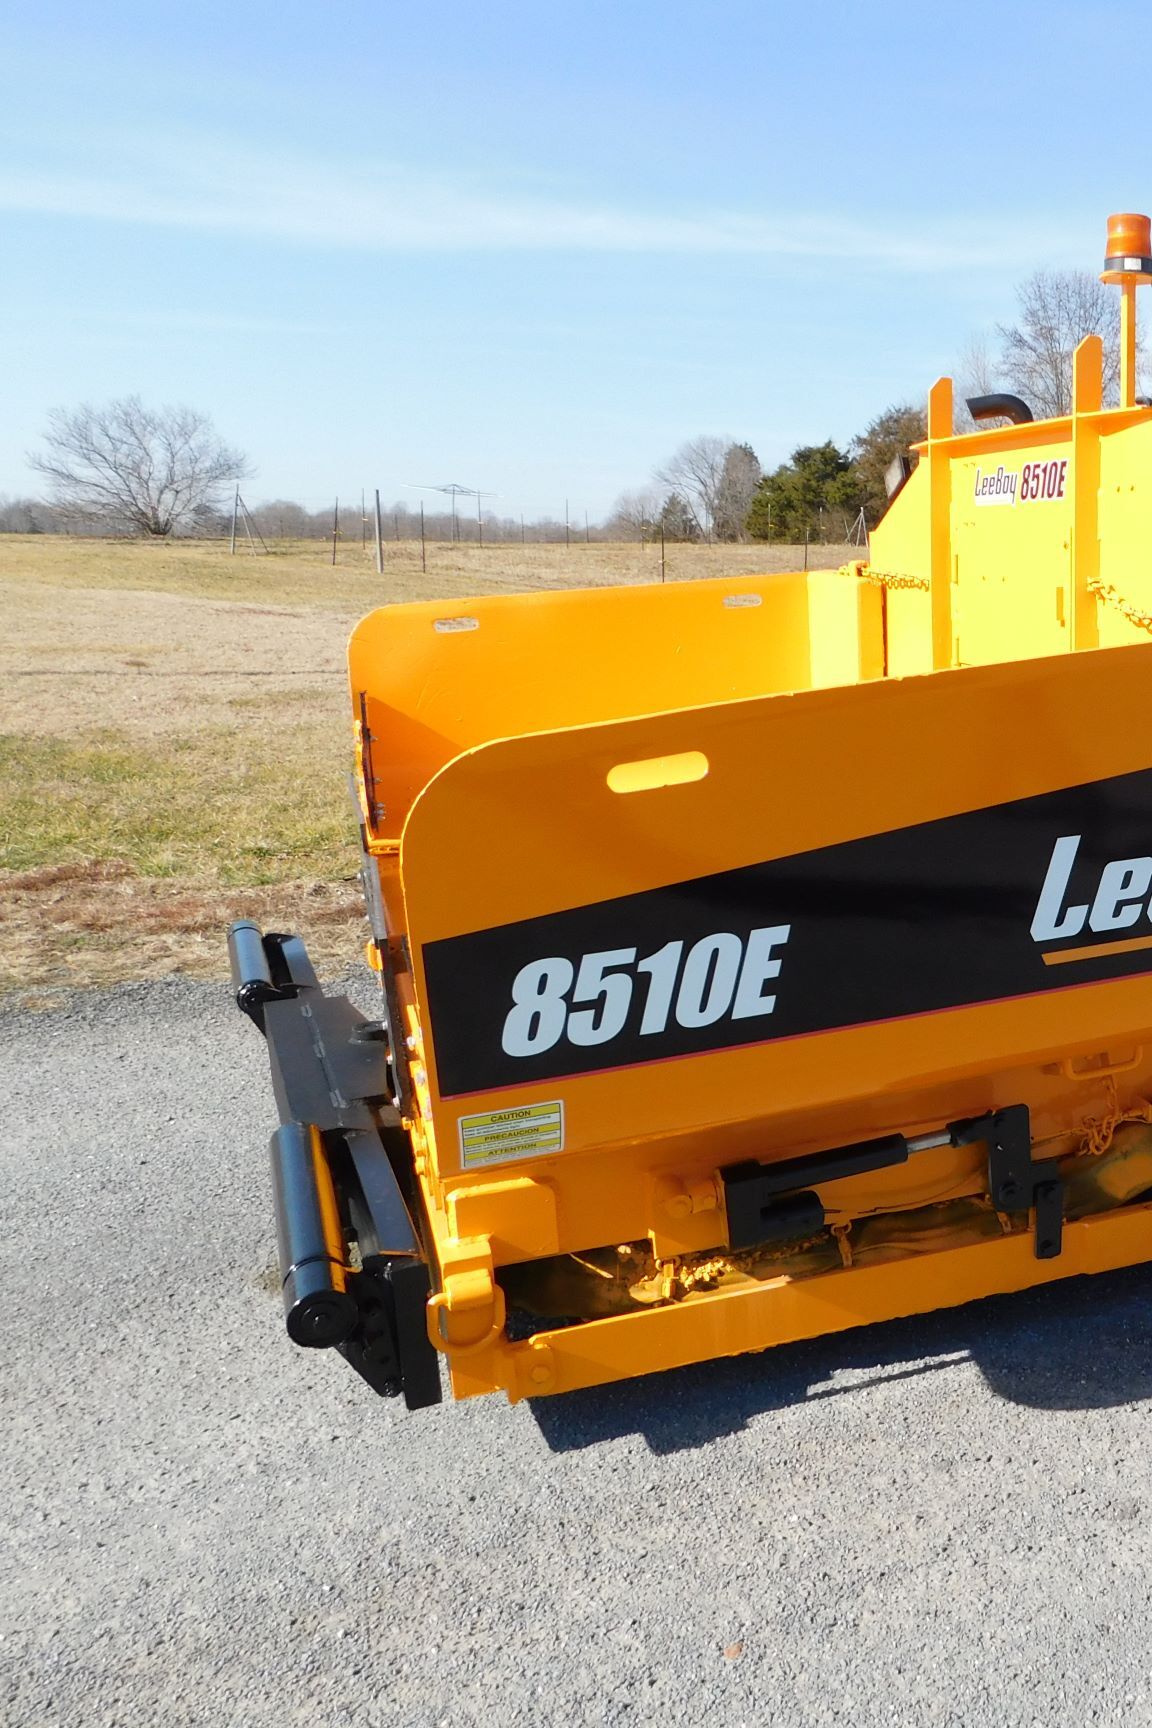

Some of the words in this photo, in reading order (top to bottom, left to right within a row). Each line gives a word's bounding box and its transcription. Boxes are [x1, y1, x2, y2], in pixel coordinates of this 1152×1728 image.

[975, 467, 1018, 504] LeeBoy
[1020, 460, 1068, 500] 8510E
[501, 924, 791, 1059] 8510E
[490, 1109, 531, 1123] CAUTION
[484, 1127, 540, 1143] PRECAUCION
[487, 1143, 537, 1156] ATTENTION
